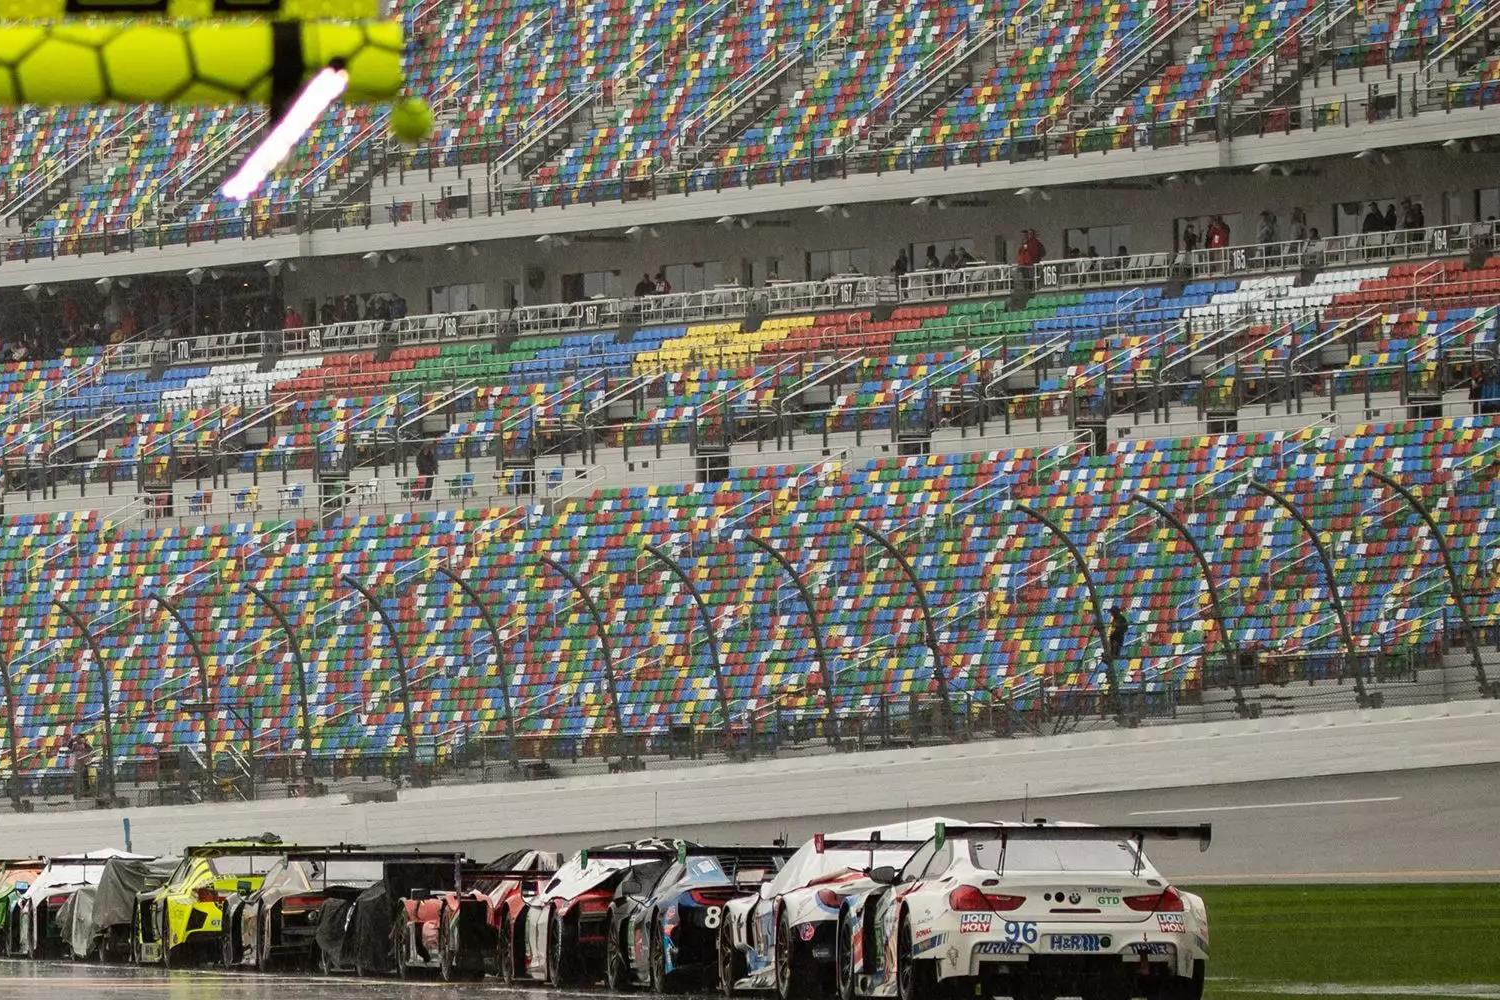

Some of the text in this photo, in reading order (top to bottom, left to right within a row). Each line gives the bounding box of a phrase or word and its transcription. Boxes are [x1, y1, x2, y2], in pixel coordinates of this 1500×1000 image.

[1434, 229, 1448, 250] 164
[1233, 249, 1246, 271] 165
[1042, 266, 1058, 286] 166
[840, 283, 853, 303] 167
[584, 305, 598, 325] 167
[177, 341, 190, 359] 170
[1098, 896, 1120, 905] GTD
[961, 923, 990, 932] MOLY
[962, 914, 991, 923] LIQUI
[1158, 914, 1184, 923] LIQUI
[1161, 923, 1186, 932] MOLY
[1004, 922, 1038, 943] 96
[1051, 935, 1081, 949] H&R
